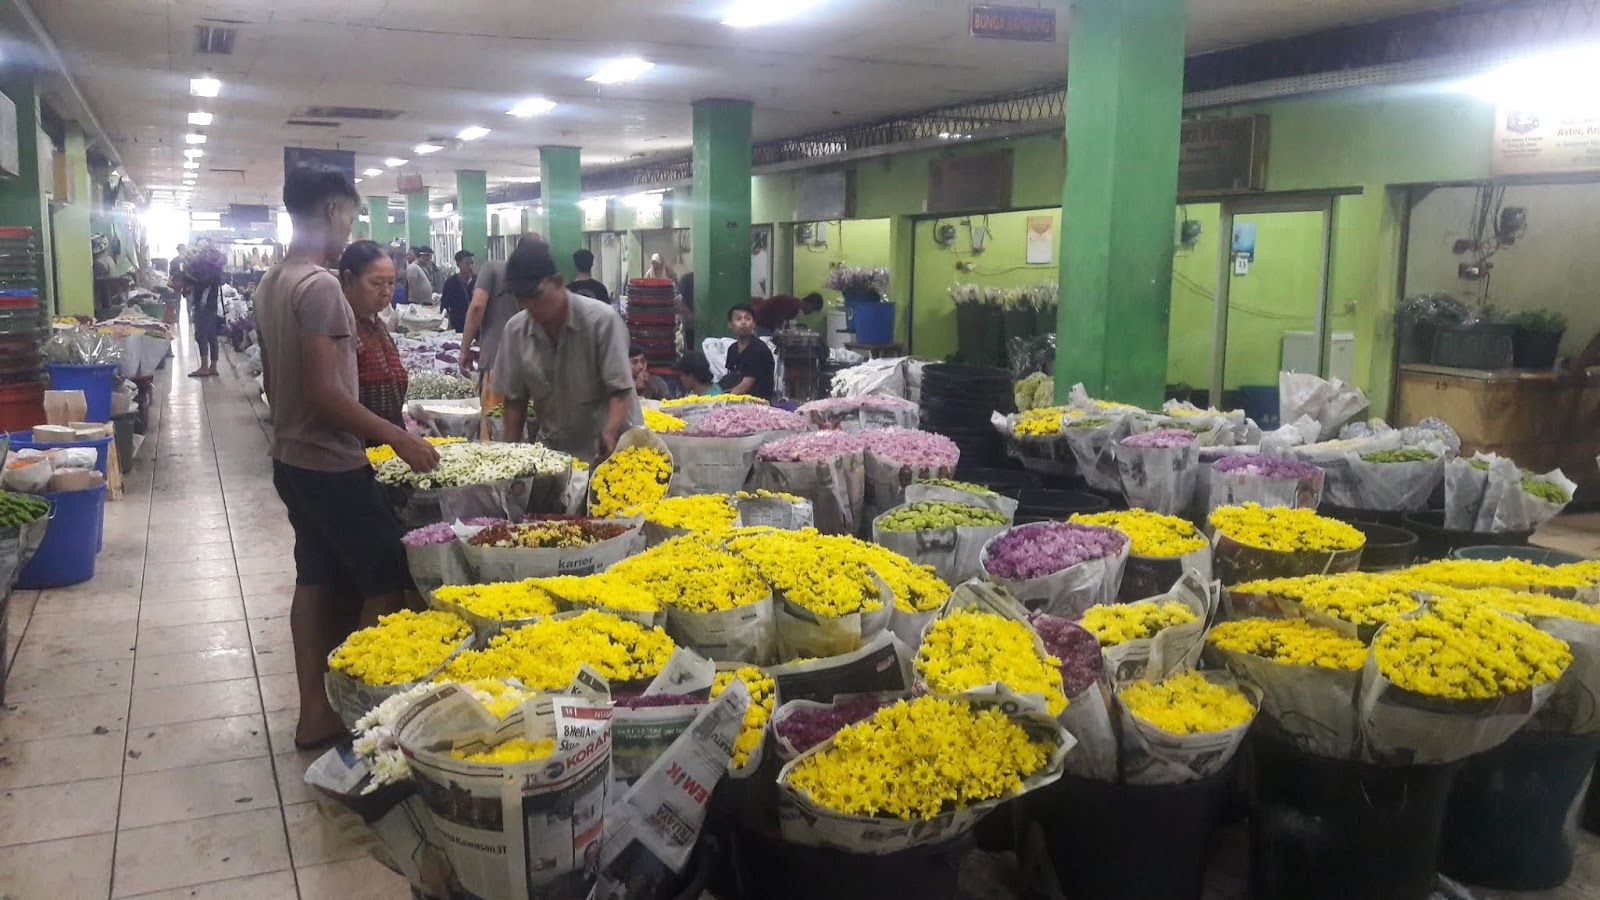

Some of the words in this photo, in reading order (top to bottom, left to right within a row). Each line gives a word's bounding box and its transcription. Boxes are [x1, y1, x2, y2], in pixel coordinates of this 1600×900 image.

[1557, 126, 1584, 137] Aster,
[558, 556, 594, 569] karier
[565, 707, 574, 716] 14
[563, 725, 570, 737] 8
[566, 729, 611, 769] KORAN
